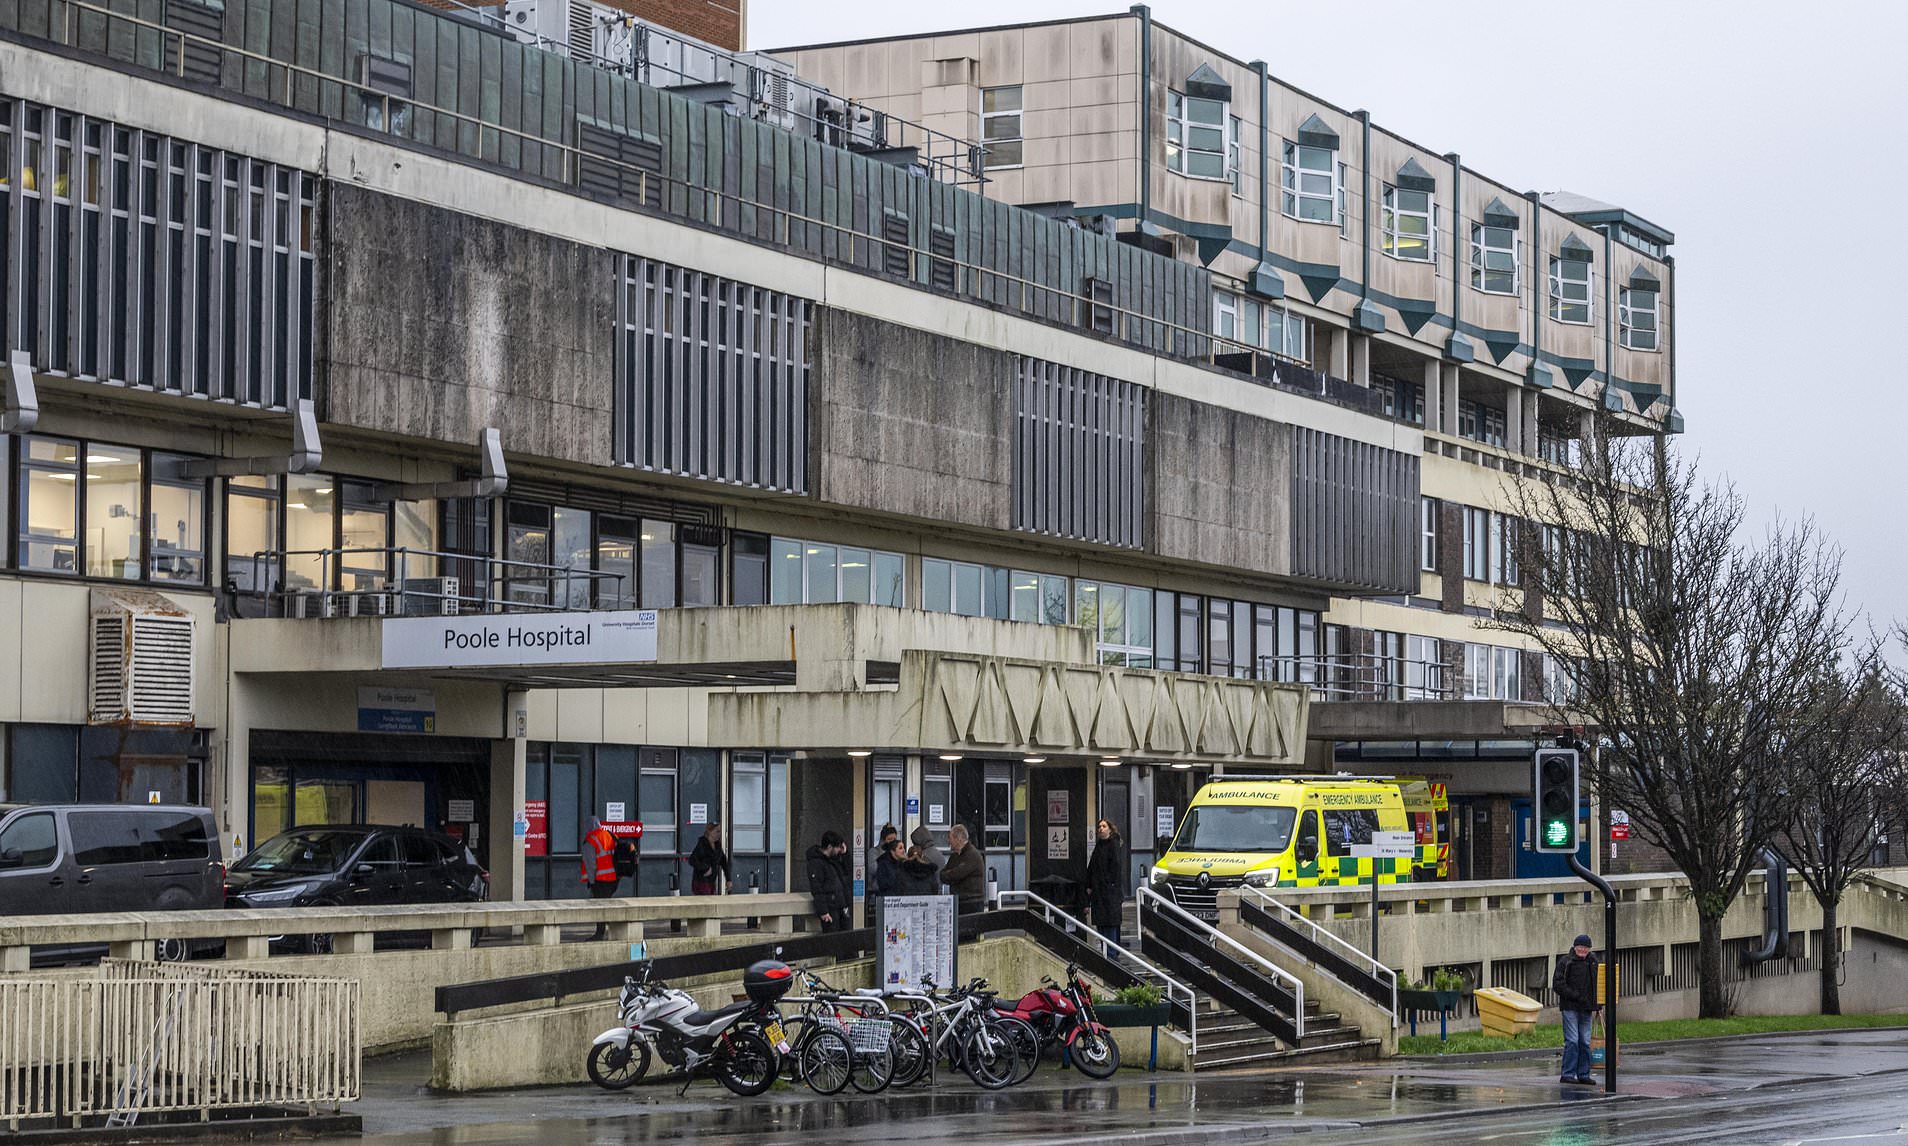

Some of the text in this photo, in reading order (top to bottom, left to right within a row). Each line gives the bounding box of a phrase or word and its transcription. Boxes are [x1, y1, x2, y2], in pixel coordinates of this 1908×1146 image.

[444, 623, 591, 652] Poole Hospital
[1211, 791, 1281, 801] AMBULANCE
[1323, 794, 1383, 806] EMERGENCY AMBULANCE
[616, 825, 636, 833] EMERGENCY
